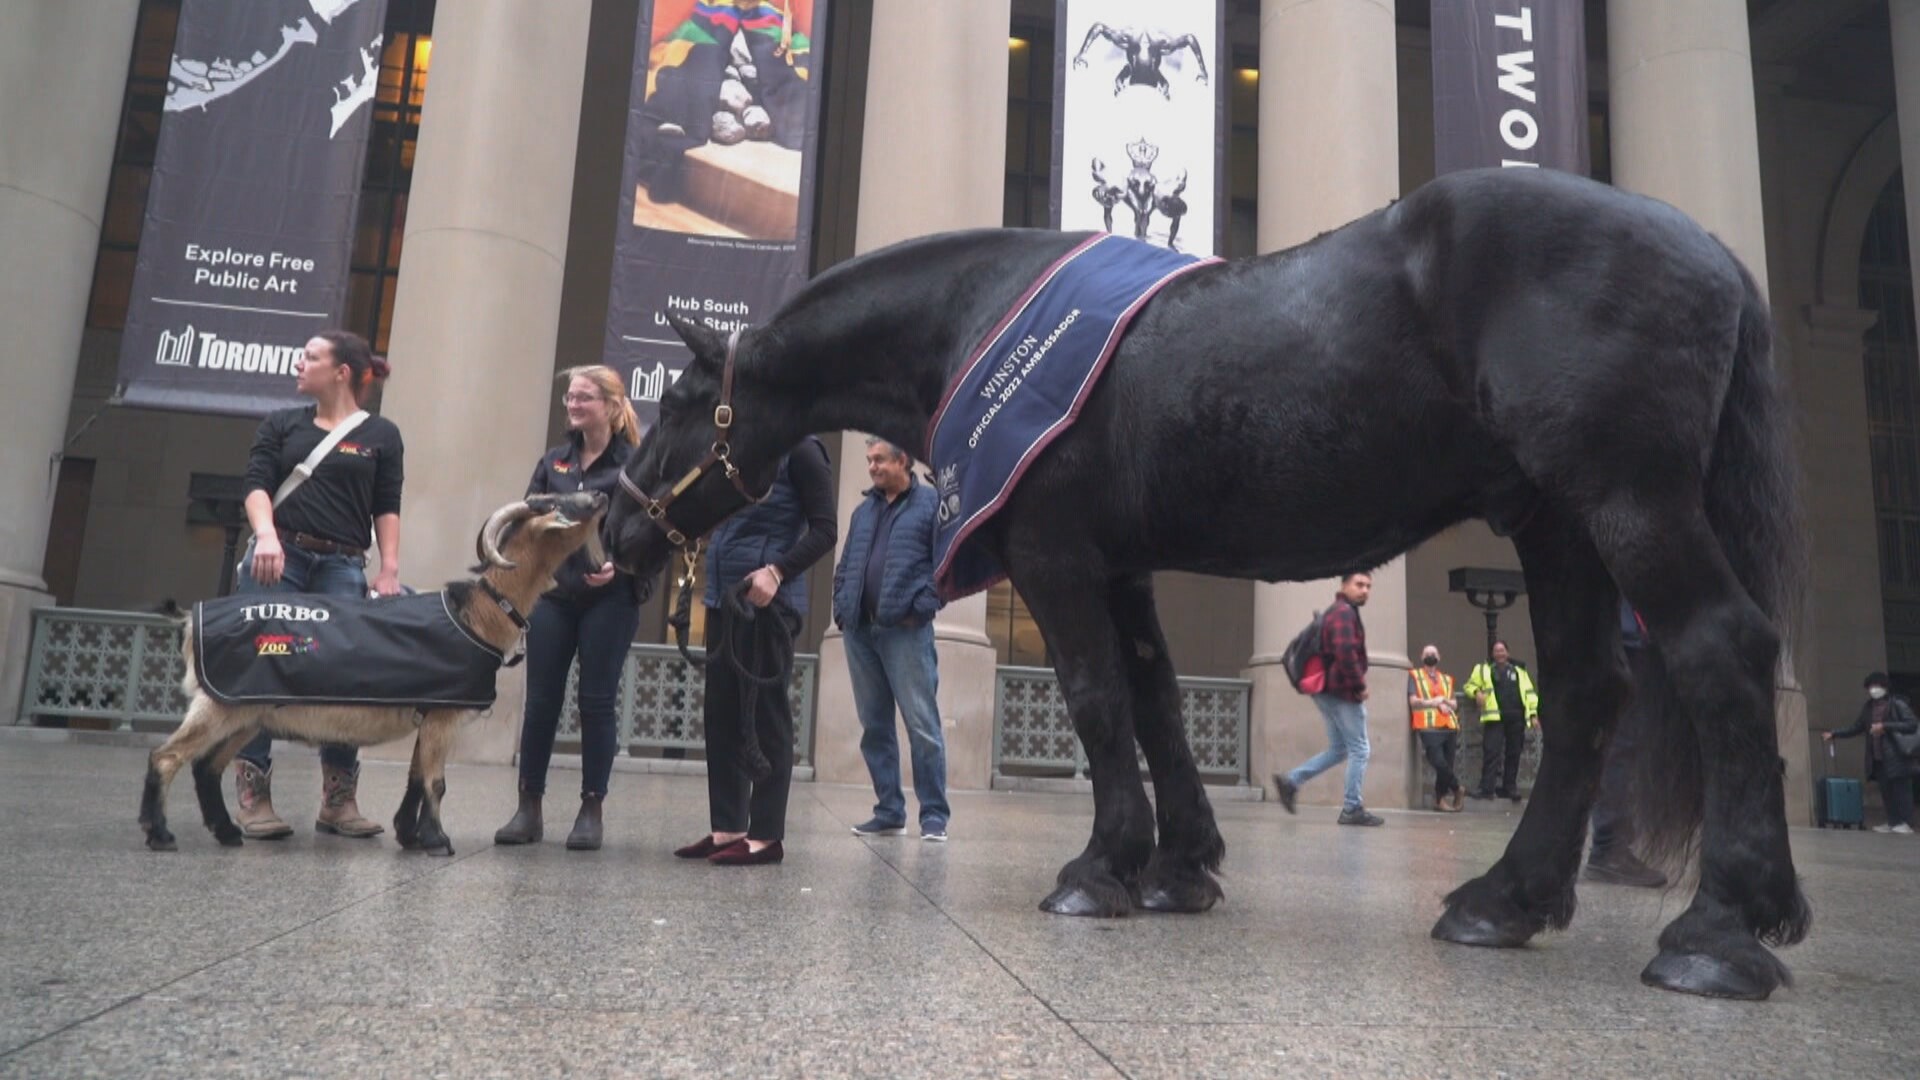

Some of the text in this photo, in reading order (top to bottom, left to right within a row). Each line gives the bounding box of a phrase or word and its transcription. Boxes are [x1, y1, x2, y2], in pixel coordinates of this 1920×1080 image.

[1494, 7, 1539, 168] TWO
[185, 243, 315, 272] Explore Free
[194, 267, 298, 294] Public Art
[668, 295, 749, 315] Hub South
[968, 308, 1082, 449] OFFICIAL 2022 AMBASSADOR
[980, 334, 1038, 399] WINSTON
[240, 603, 330, 622] TURBO
